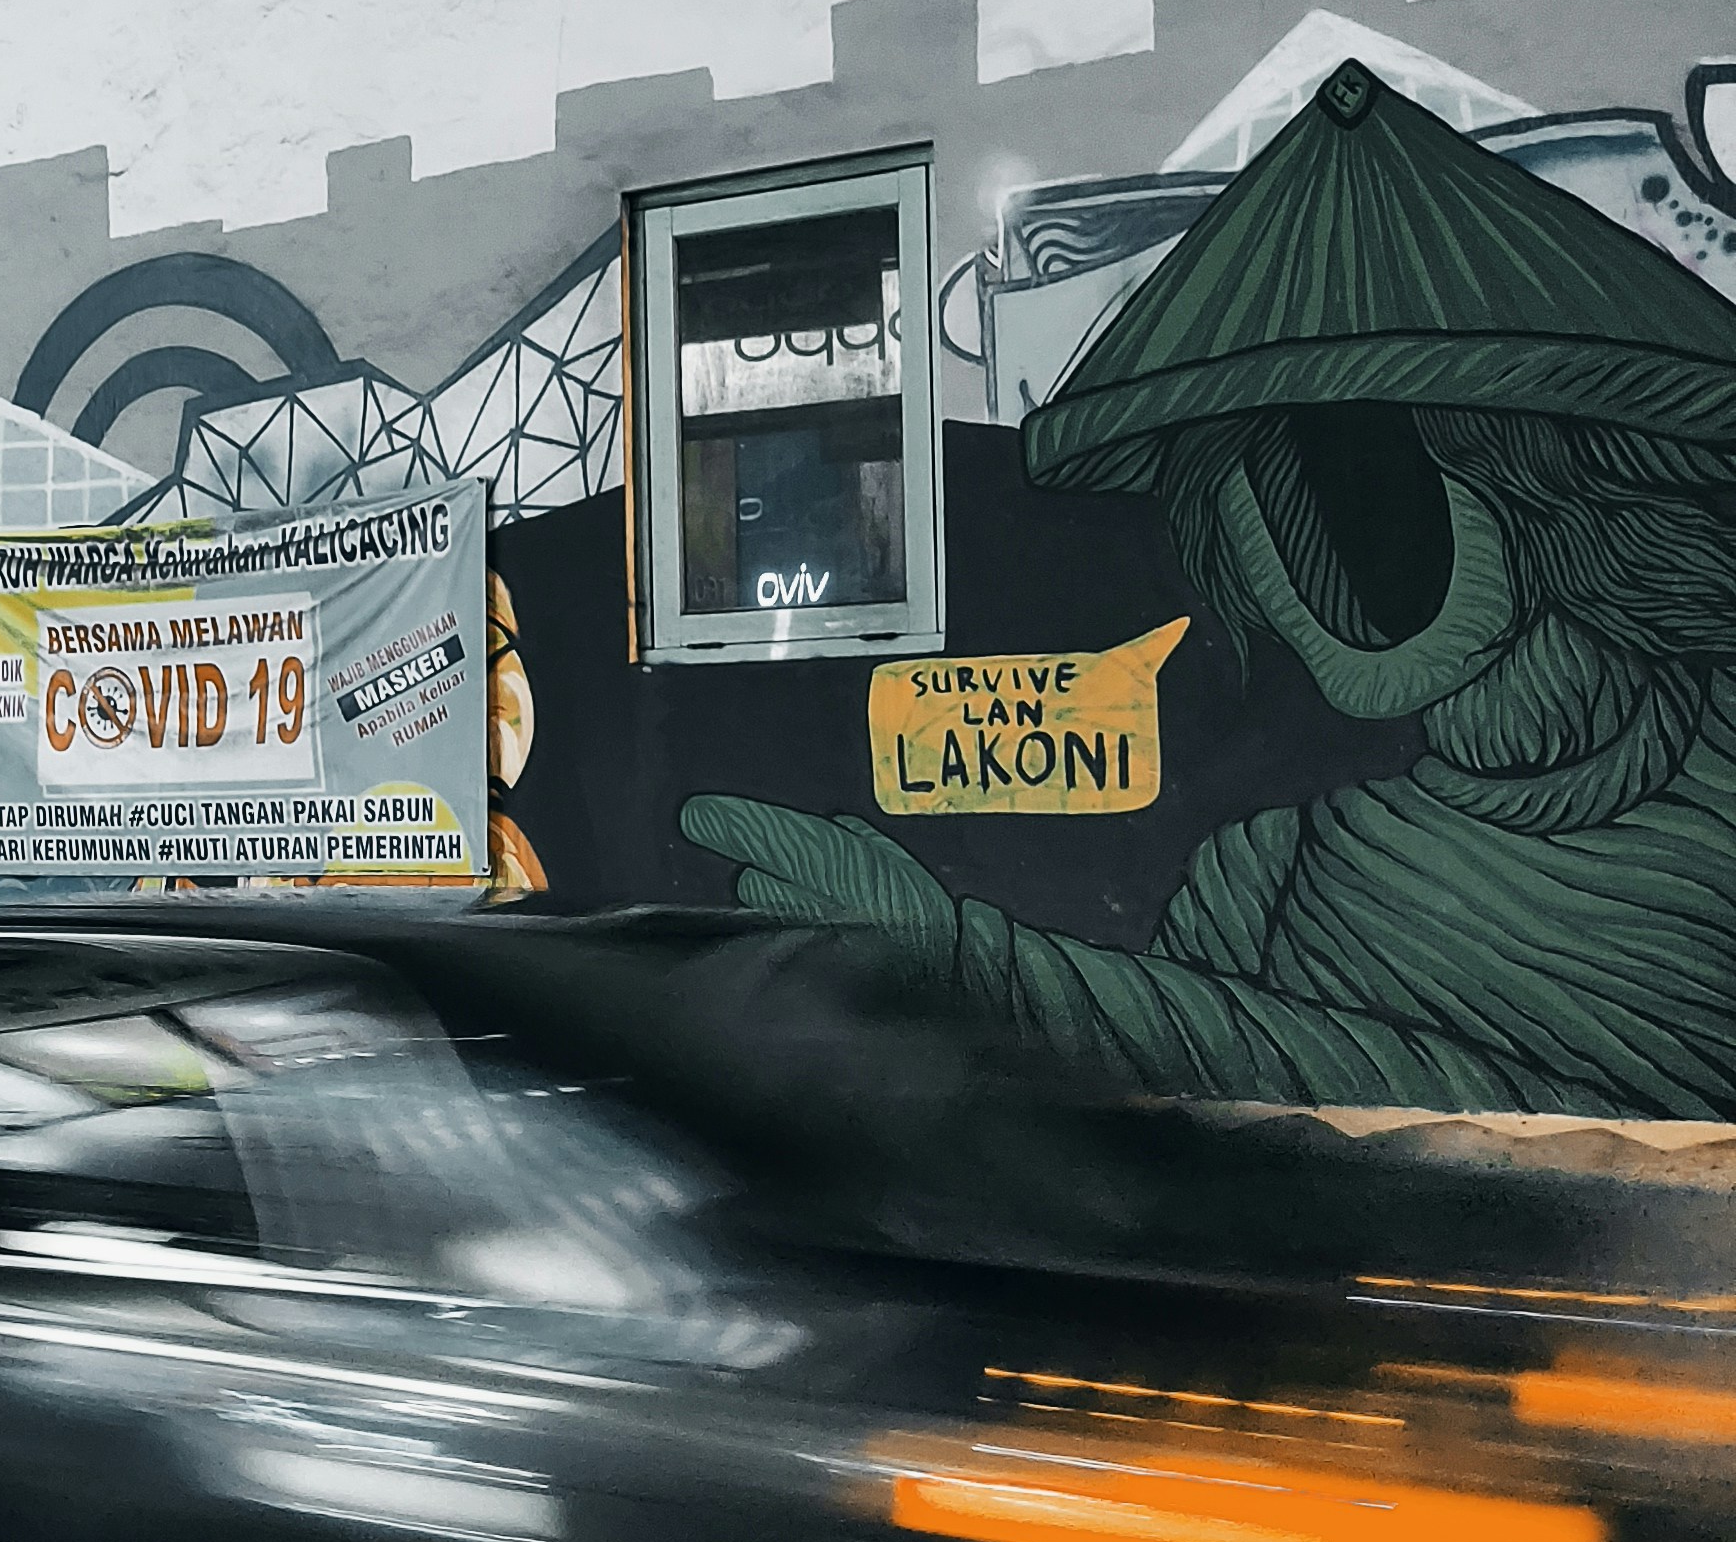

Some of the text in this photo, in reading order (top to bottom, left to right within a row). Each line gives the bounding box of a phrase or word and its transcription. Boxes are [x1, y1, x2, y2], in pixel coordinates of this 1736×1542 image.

[46, 539, 136, 587] WARGA
[140, 534, 271, 580] Kelurahan
[274, 503, 449, 569] KALICACING
[47, 610, 304, 655] BERSAMA MELAWAN
[327, 611, 458, 694] WAJIB MENGGUNAKAN
[248, 655, 306, 745] 19
[353, 646, 449, 711] MASKER
[357, 670, 466, 739] Apabila Keluar
[910, 662, 1081, 698] SURVIVE
[392, 704, 449, 747] RUMAH
[963, 697, 1044, 728] LAN
[897, 729, 1130, 795] LAKONI
[35, 804, 123, 828] DIRUMAH
[128, 803, 195, 827] #CUCI
[200, 801, 284, 826] TANGAN
[292, 799, 356, 825] PAKAI
[363, 797, 434, 823] SABUN
[32, 838, 152, 862] KERUMUNAN
[158, 837, 228, 861] #IKUTI
[235, 836, 320, 861] ATURAN
[326, 834, 462, 860] PEMERINTAH
